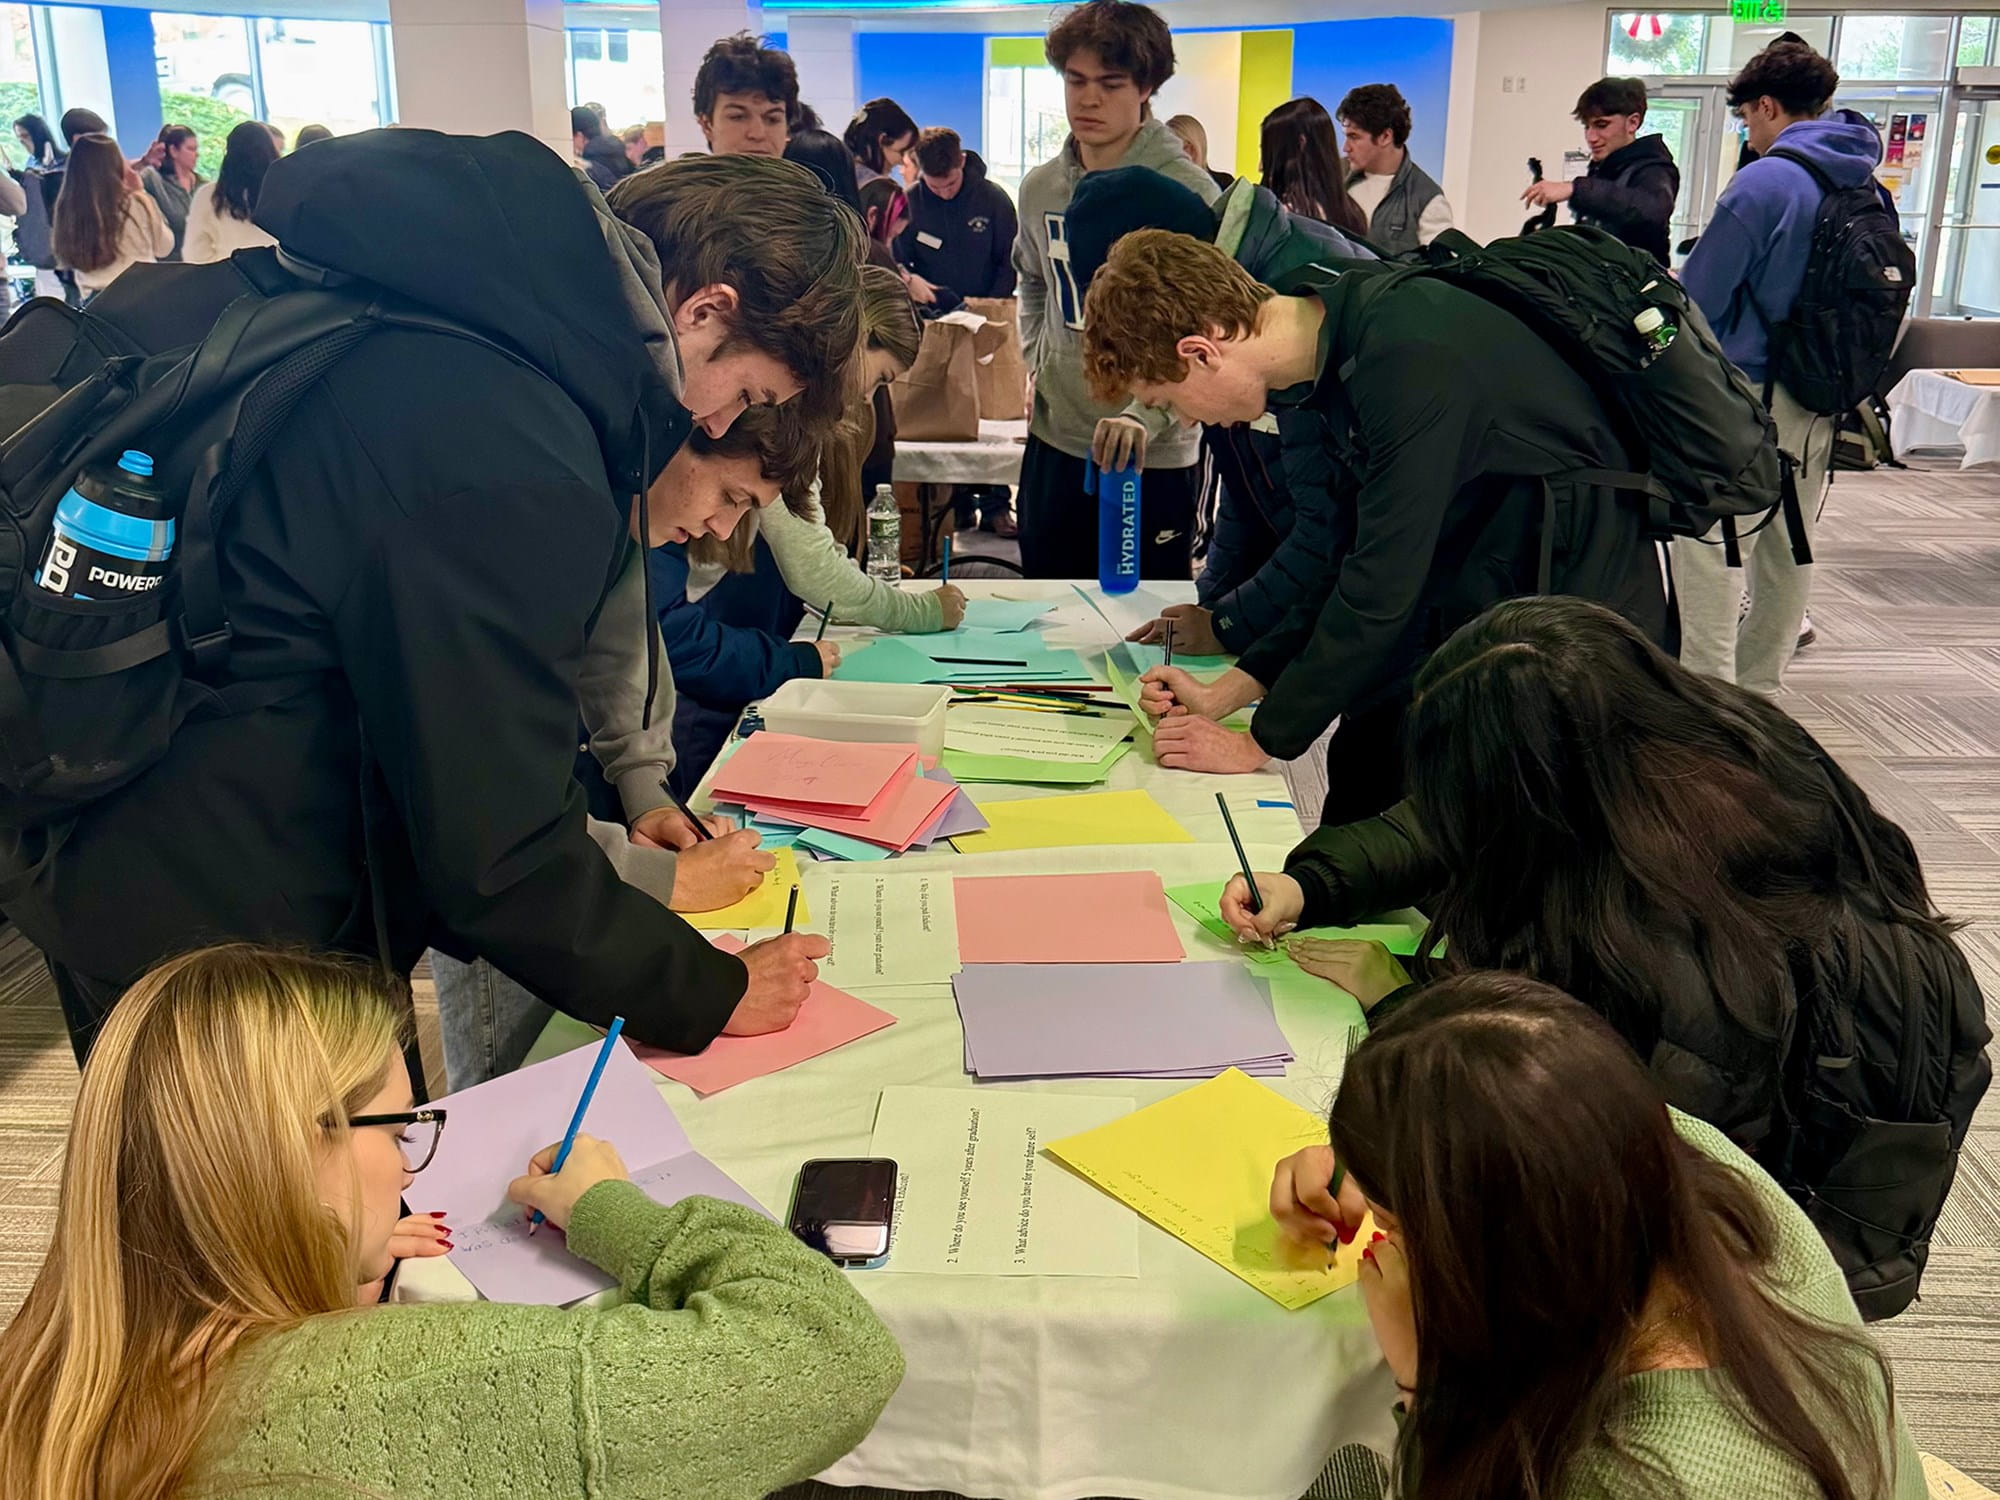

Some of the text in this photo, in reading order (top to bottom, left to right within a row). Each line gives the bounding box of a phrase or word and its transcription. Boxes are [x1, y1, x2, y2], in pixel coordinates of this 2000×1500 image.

[1122, 481, 1136, 575] HYDRATED
[967, 1107, 980, 1143] graduation?
[964, 1143, 976, 1156] after
[964, 1157, 975, 1172] years
[960, 1176, 971, 1201] yourself
[1013, 1126, 1037, 1264] 3. What advice do you have for your future self?
[958, 1201, 968, 1211] see
[956, 1212, 967, 1224] you
[952, 1224, 964, 1233] do
[948, 1233, 963, 1254] Where
[946, 1256, 959, 1264] 2.
